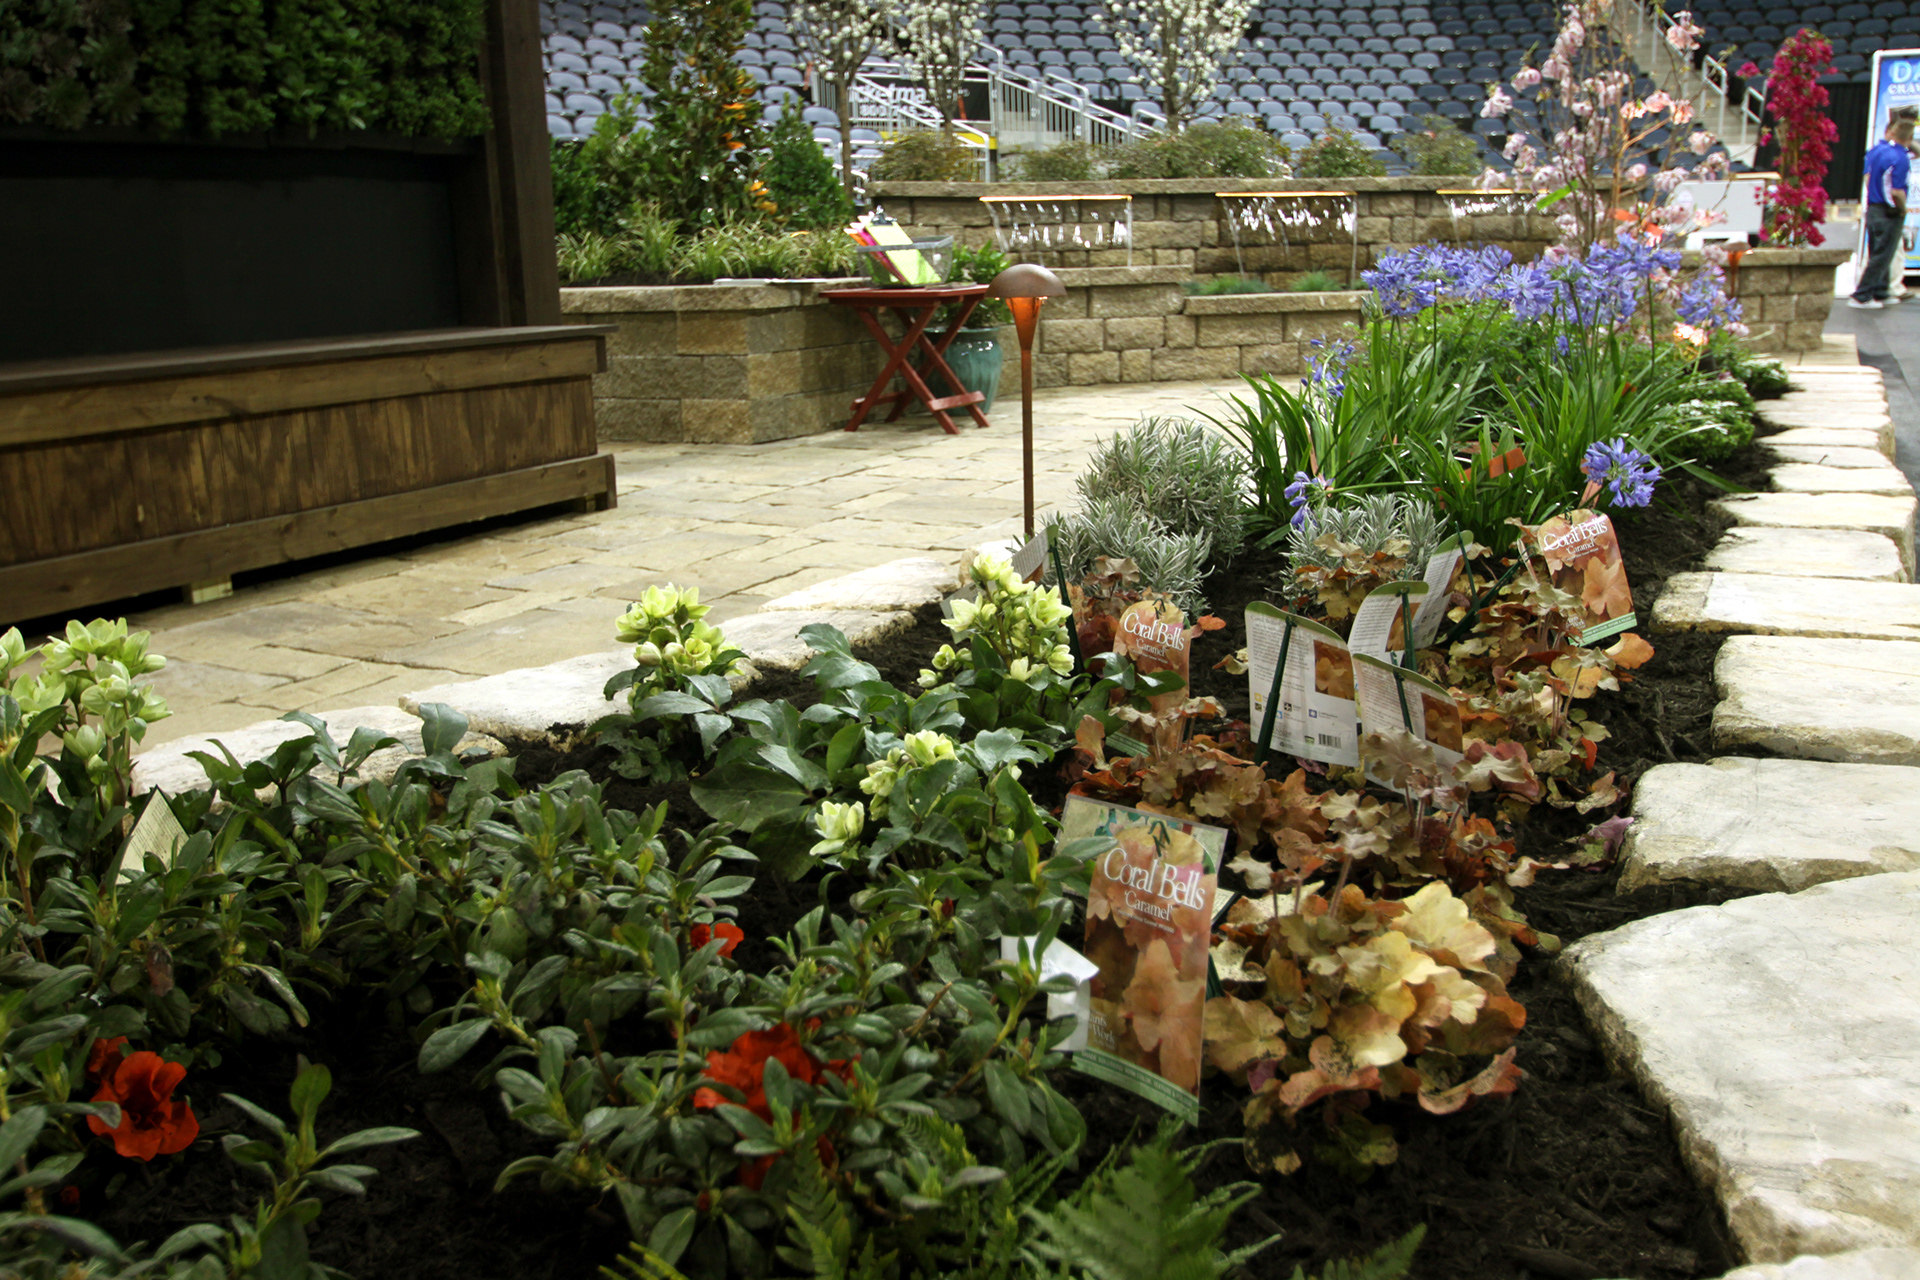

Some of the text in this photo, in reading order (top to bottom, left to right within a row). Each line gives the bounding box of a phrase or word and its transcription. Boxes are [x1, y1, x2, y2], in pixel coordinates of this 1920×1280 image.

[1543, 517, 1609, 551] Coral Bells
[1124, 612, 1185, 651] Coral Bells
[1103, 846, 1206, 911] Coral Bells
